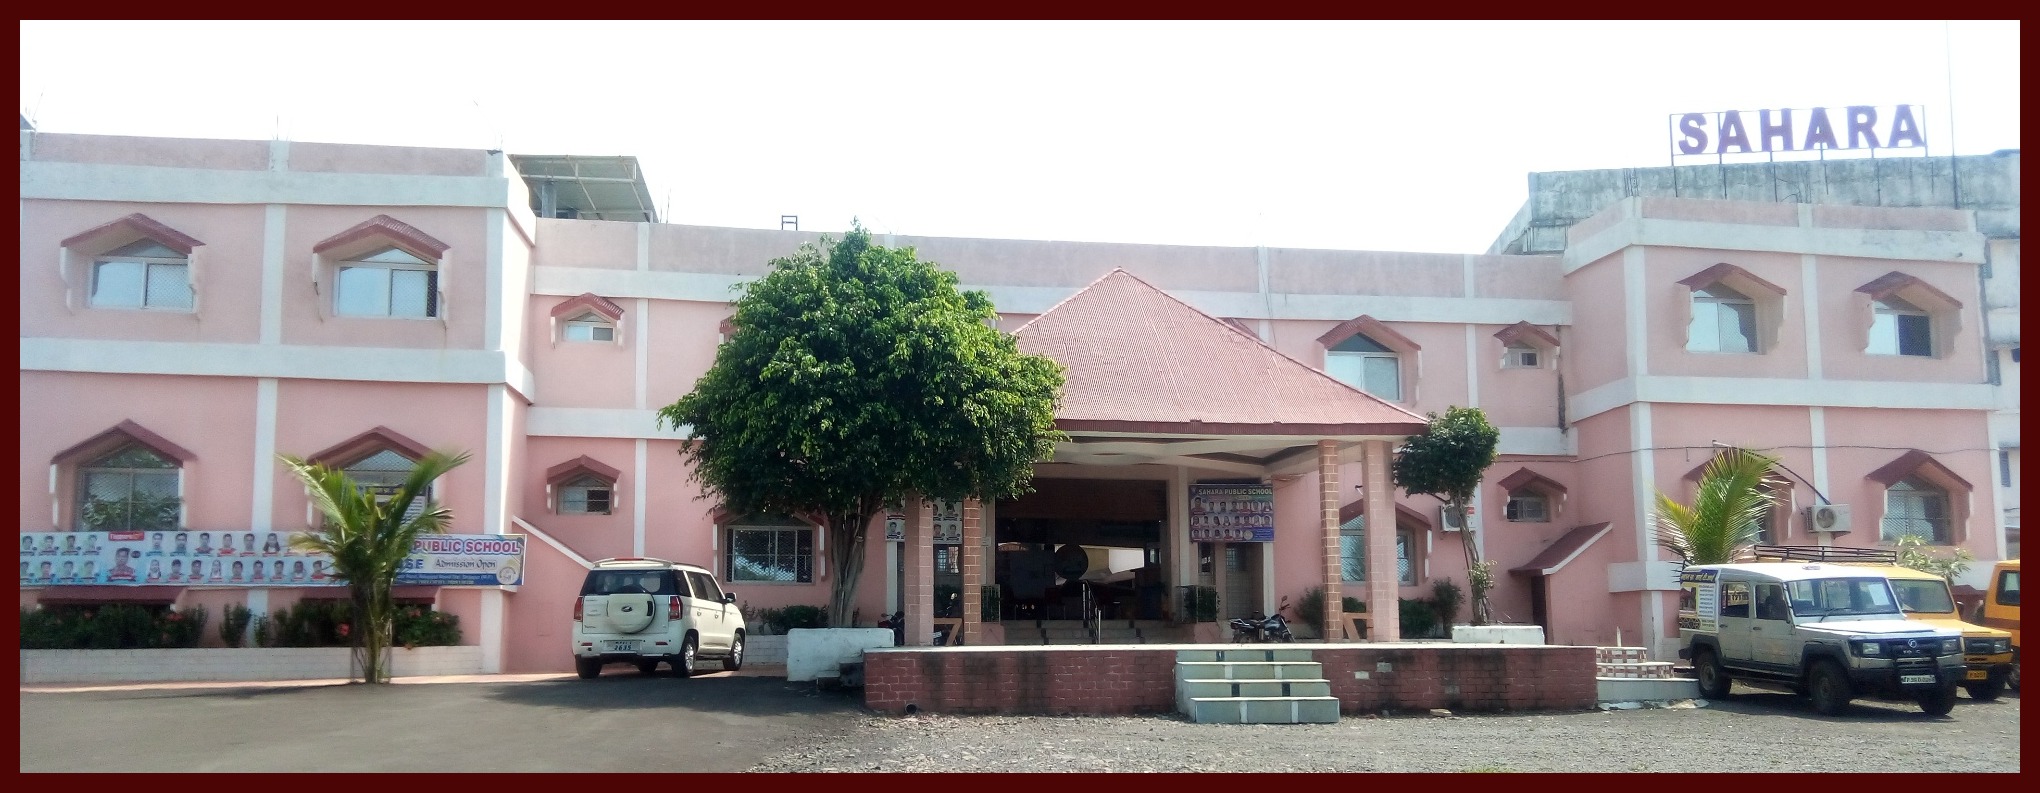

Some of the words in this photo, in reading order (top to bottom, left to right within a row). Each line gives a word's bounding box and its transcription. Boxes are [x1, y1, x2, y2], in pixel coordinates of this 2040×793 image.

[1678, 104, 1926, 155] SAHARA
[413, 540, 461, 552] PUBLIC
[465, 541, 518, 553] SCHOOL
[435, 558, 475, 569] Admission
[476, 559, 496, 570] Open
